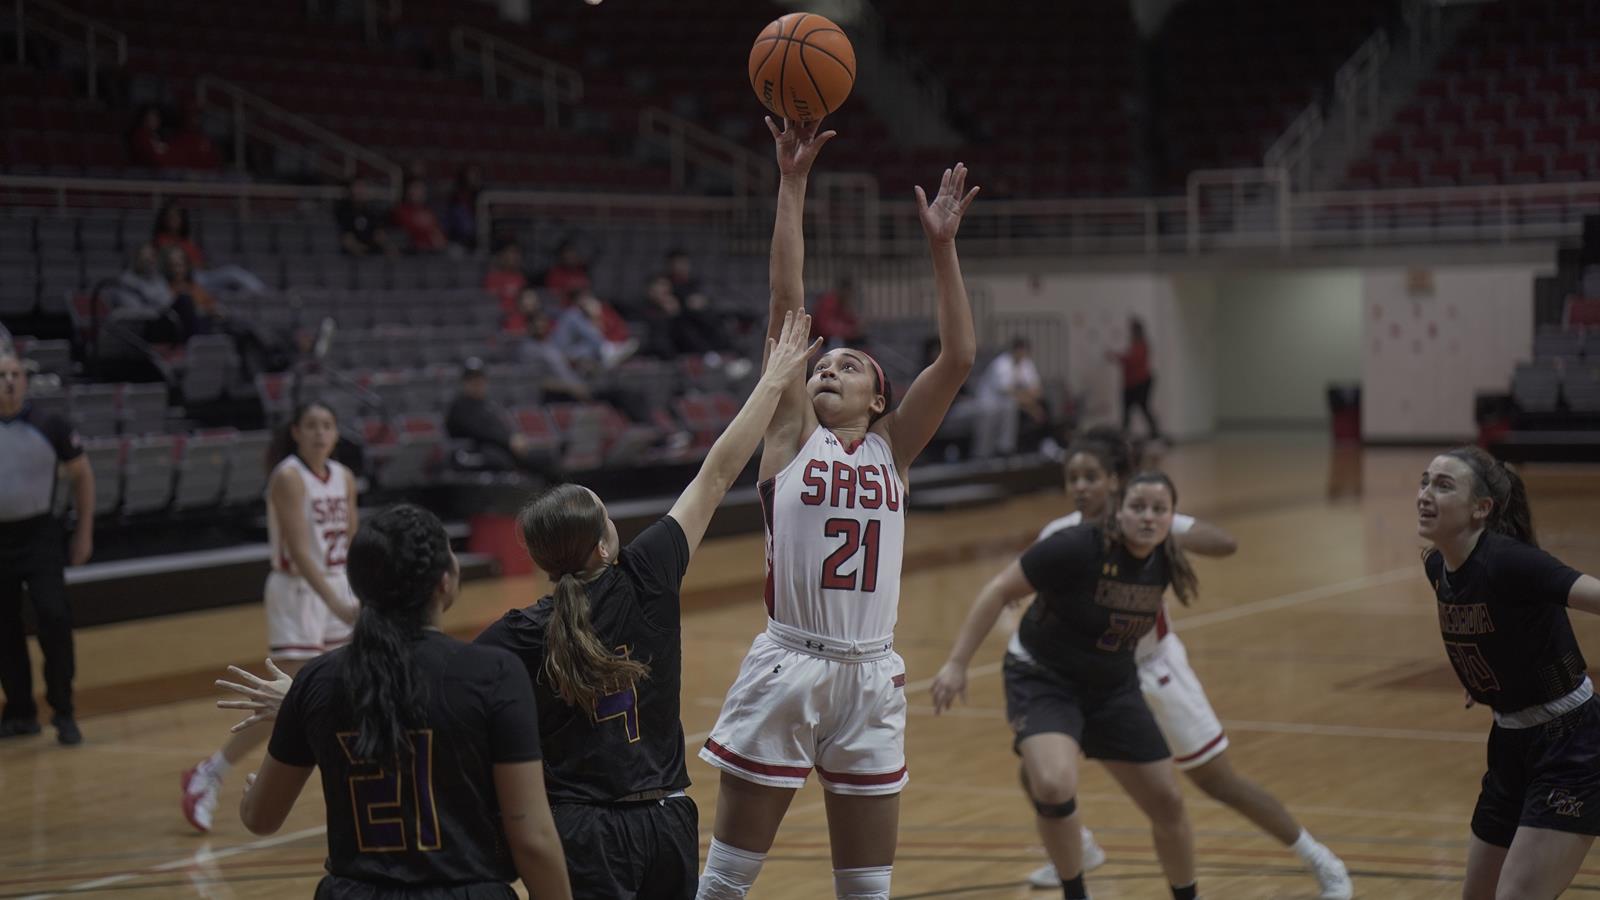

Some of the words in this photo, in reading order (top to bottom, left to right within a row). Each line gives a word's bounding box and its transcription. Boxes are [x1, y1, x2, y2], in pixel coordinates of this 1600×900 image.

[311, 496, 348, 524] SRS
[800, 459, 900, 512] SRSU
[821, 518, 881, 593] 21
[336, 729, 441, 852] 21
